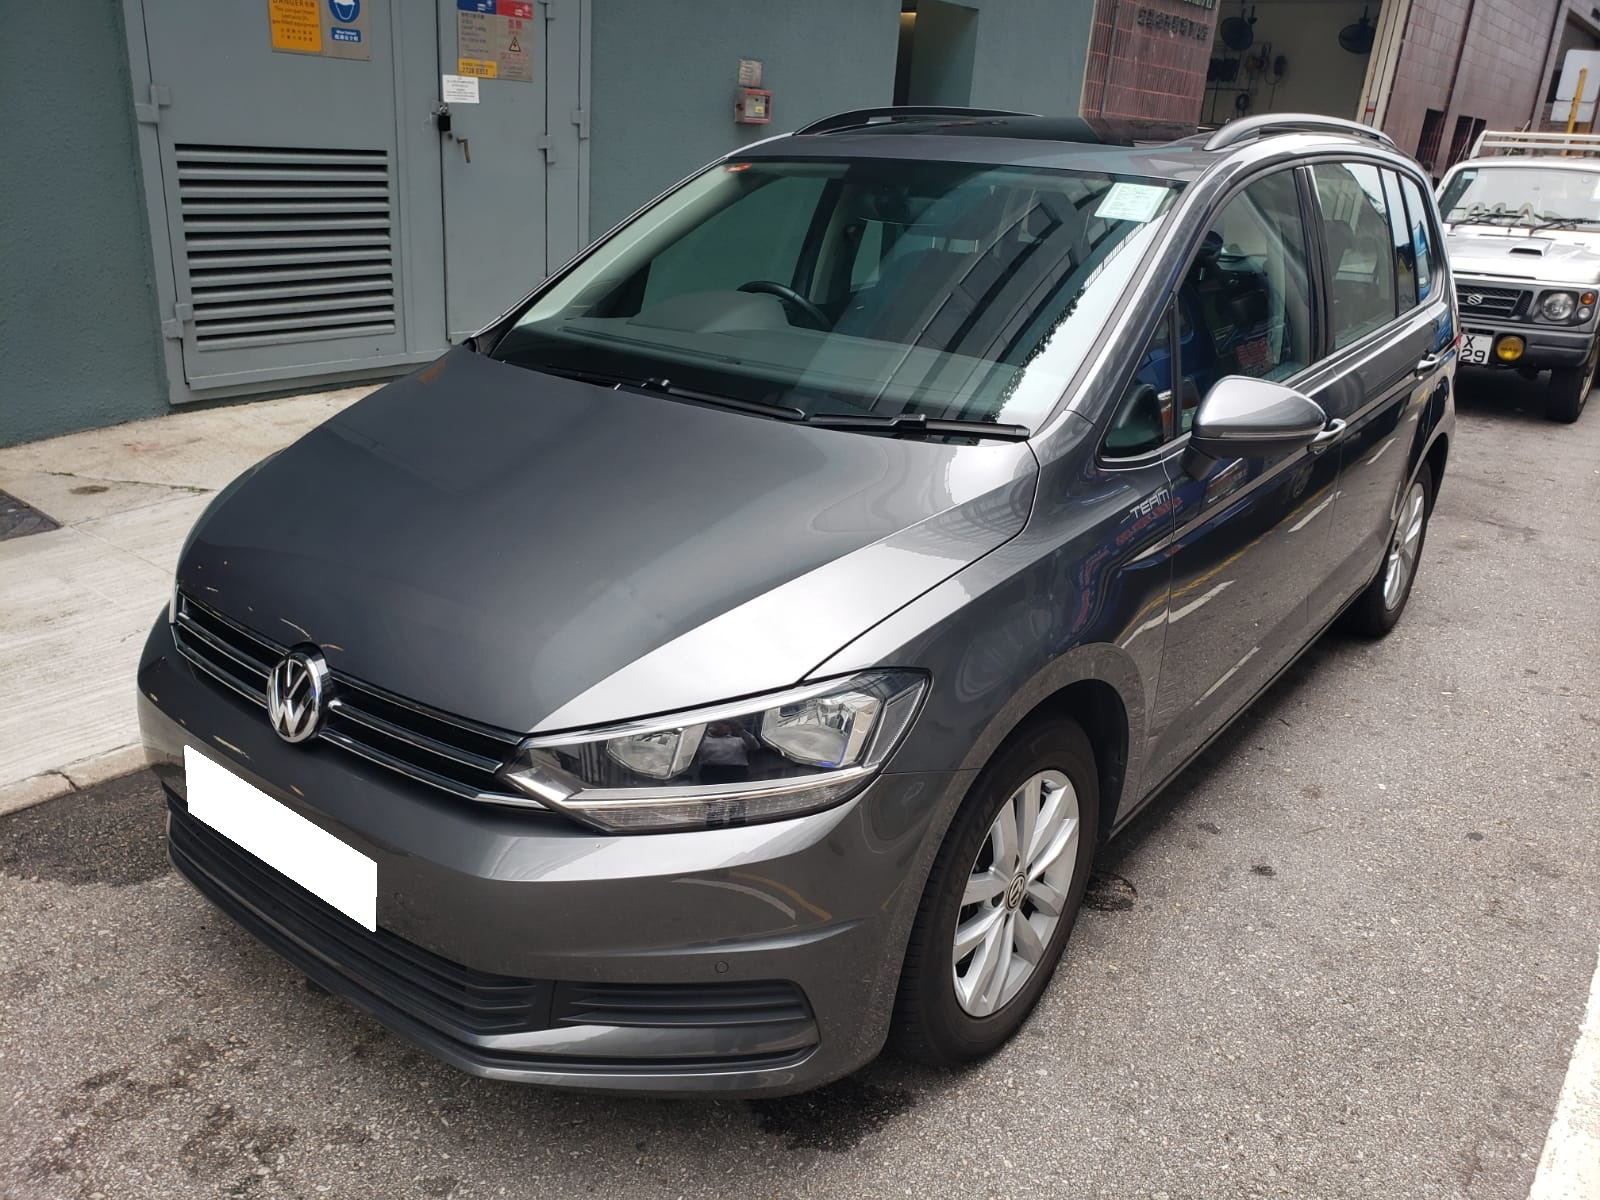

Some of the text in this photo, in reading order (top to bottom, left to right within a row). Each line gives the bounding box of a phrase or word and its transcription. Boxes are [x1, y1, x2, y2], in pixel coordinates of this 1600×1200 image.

[1463, 336, 1475, 349] X
[1460, 349, 1486, 363] 29
[1129, 488, 1170, 519] TEAM
